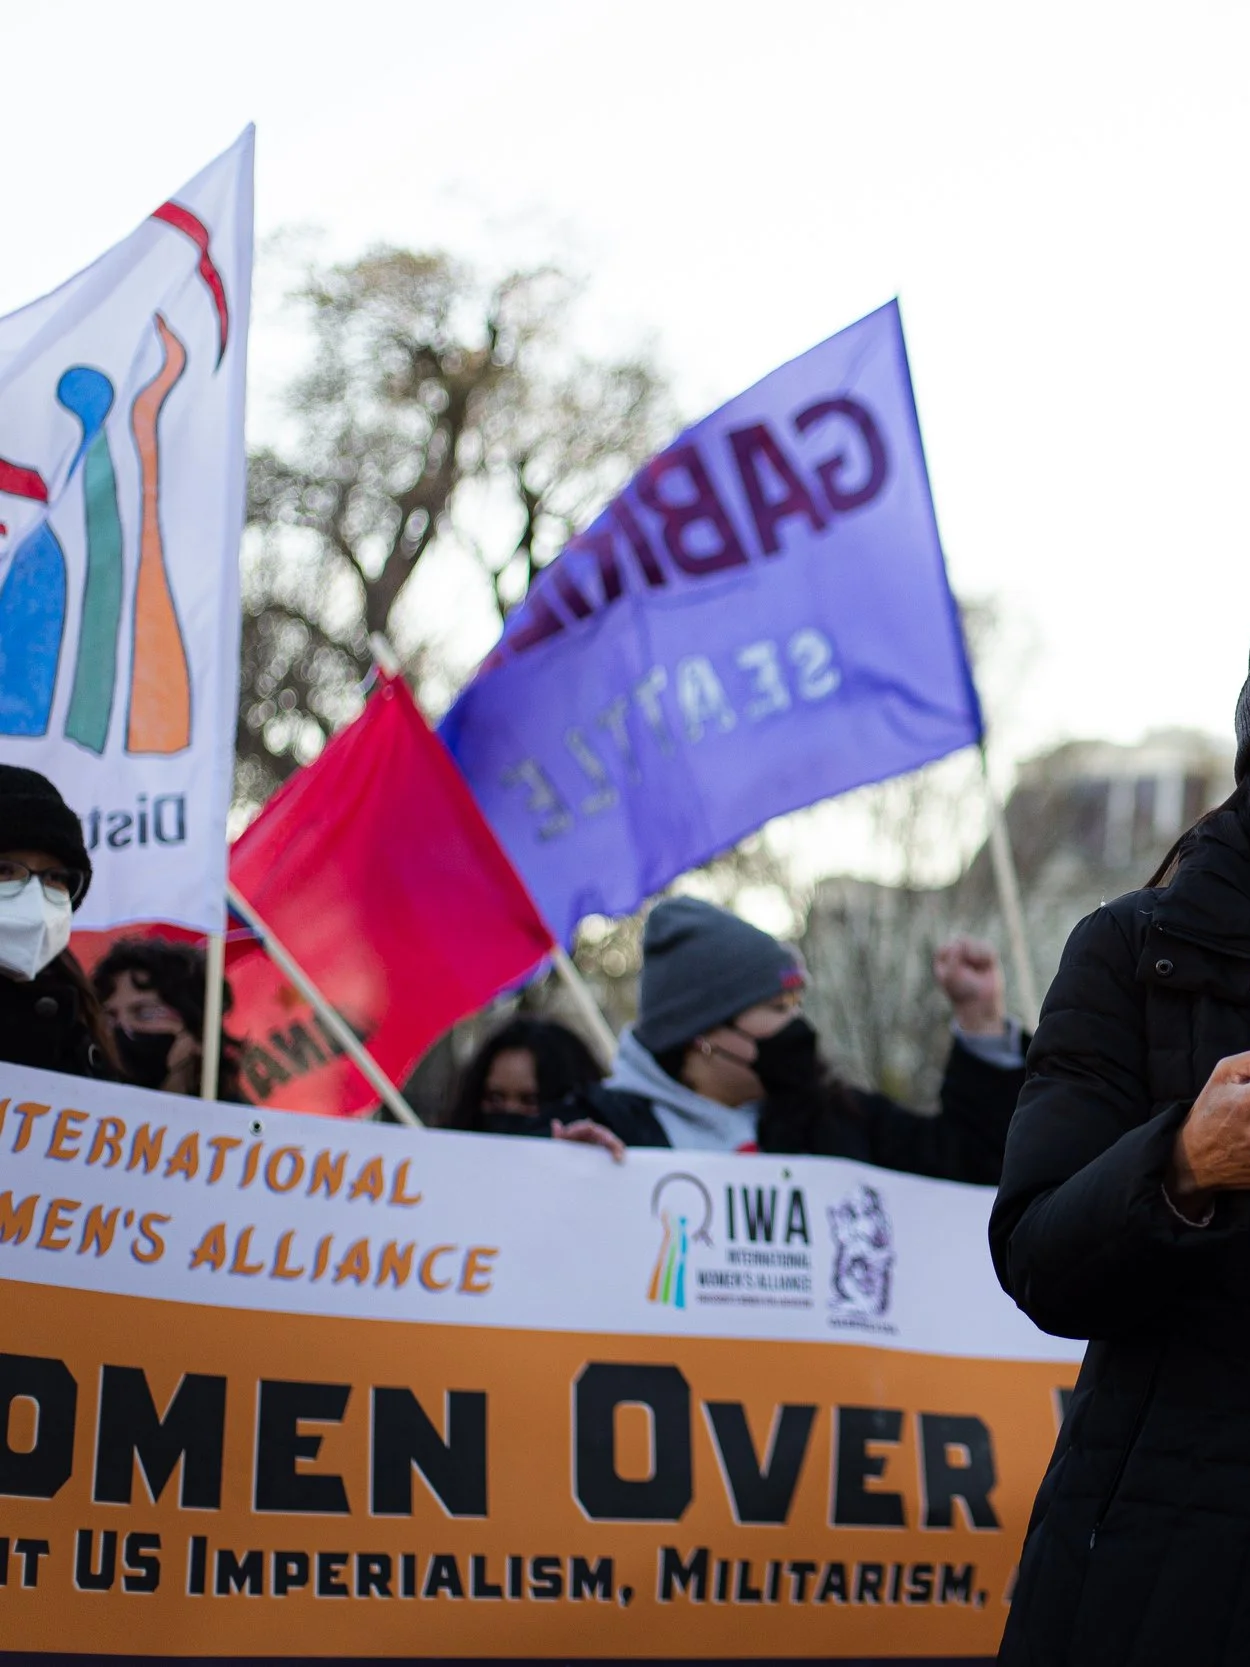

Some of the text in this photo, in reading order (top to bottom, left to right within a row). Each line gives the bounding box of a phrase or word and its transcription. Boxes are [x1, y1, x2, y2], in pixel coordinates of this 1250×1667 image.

[726, 1182, 812, 1246] IWA
[190, 1223, 499, 1294] ALLIANCE
[571, 1361, 1003, 1531] OVER
[74, 1529, 161, 1594] US
